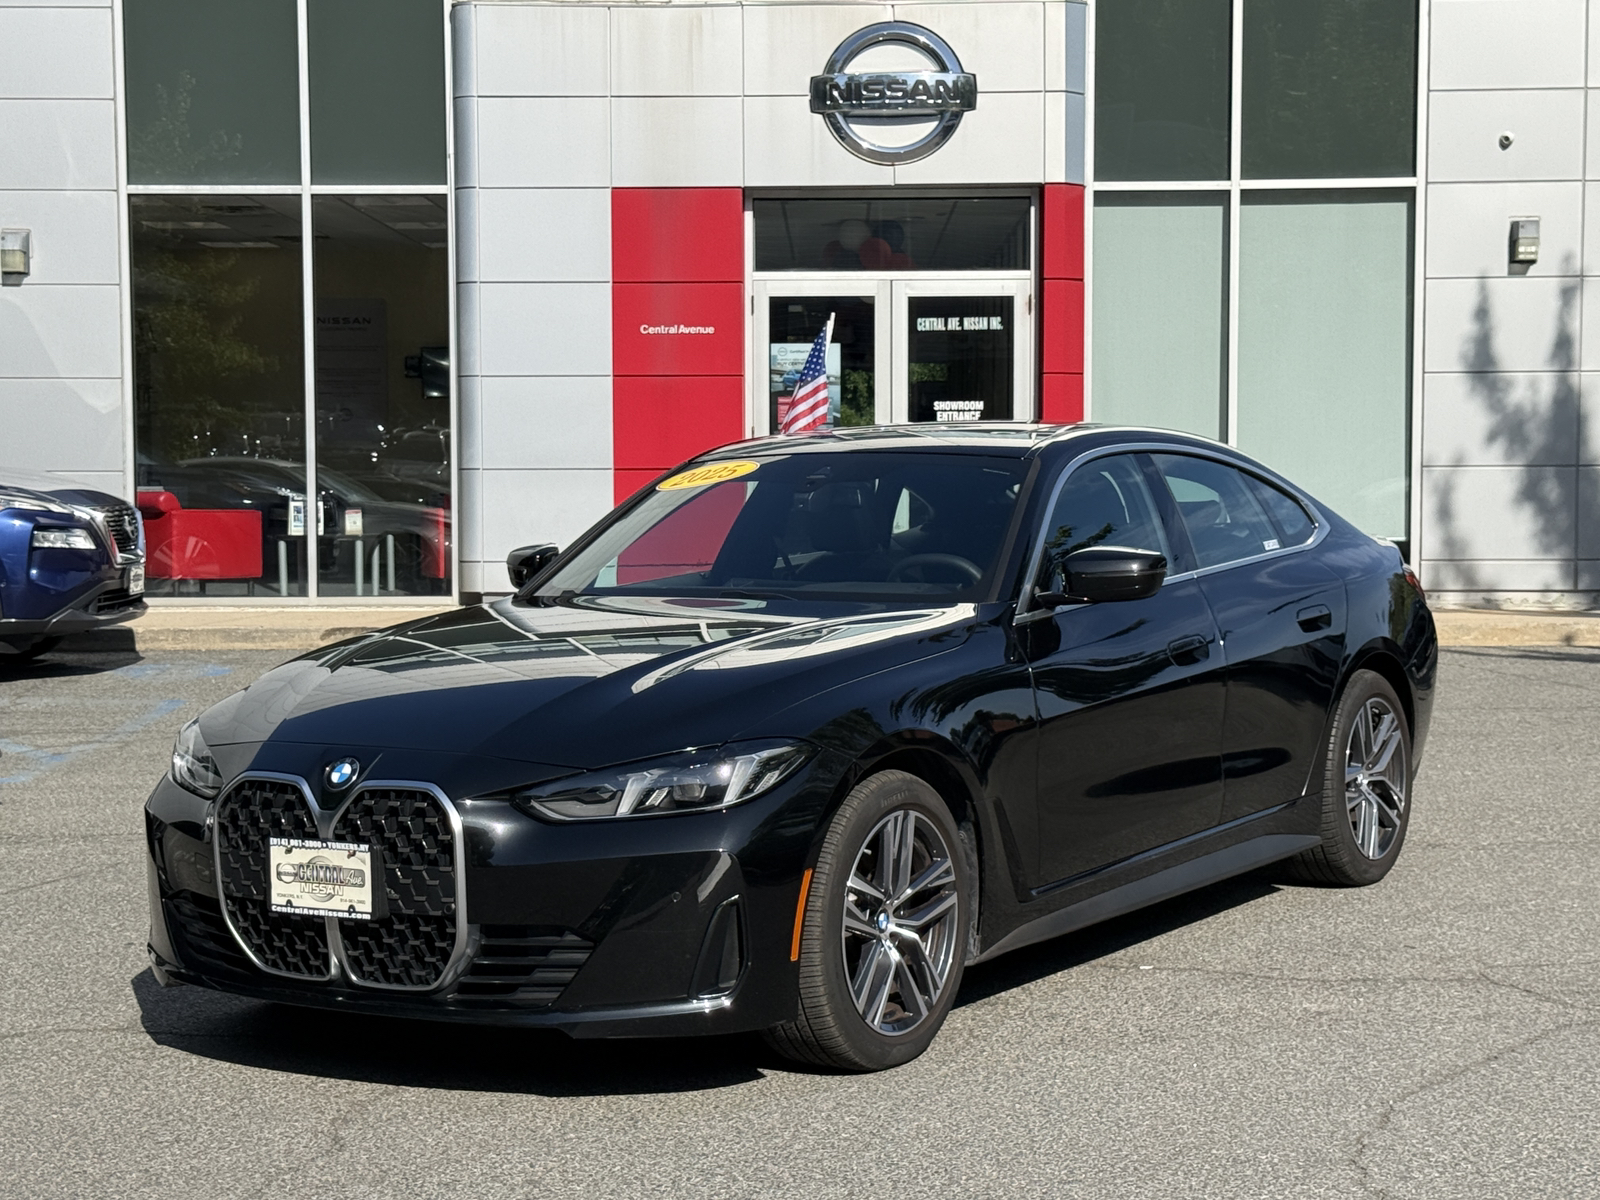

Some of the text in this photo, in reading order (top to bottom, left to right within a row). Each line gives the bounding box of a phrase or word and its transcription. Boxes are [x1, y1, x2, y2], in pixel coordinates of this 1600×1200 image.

[827, 78, 961, 104] NISSAN
[317, 317, 372, 325] NISSAN
[916, 317, 946, 331] CENTRAL
[963, 317, 988, 330] NISSAN
[640, 324, 715, 335] Central Avenue
[933, 401, 984, 410] SHOWROOM
[936, 411, 981, 421] ENTRANCE
[669, 464, 747, 487] 2025
[298, 864, 345, 884] CENTRAL
[300, 882, 344, 896] NISSAN
